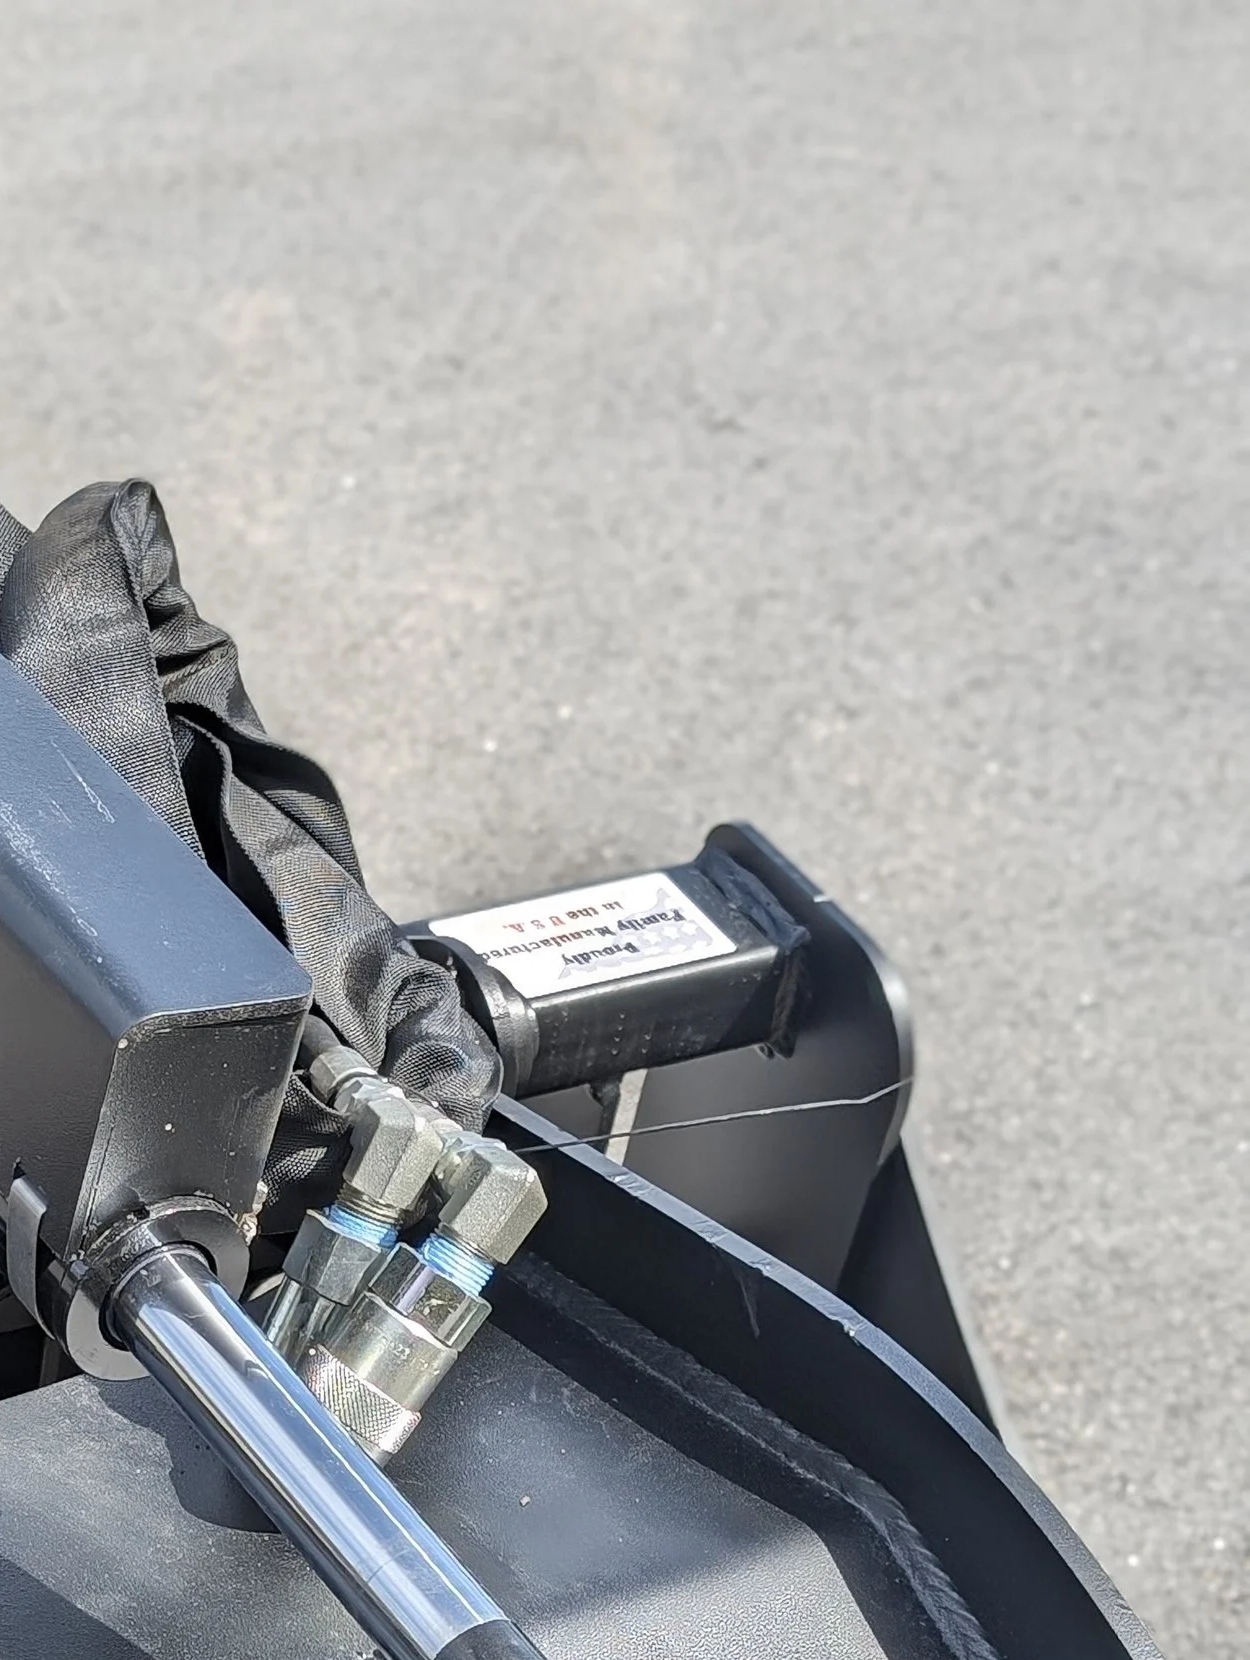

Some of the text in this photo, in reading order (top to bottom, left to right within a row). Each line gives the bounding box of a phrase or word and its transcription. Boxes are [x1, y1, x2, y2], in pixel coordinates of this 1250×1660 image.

[565, 906, 599, 920] the
[617, 909, 686, 932] Family
[561, 942, 640, 966] Proudly
